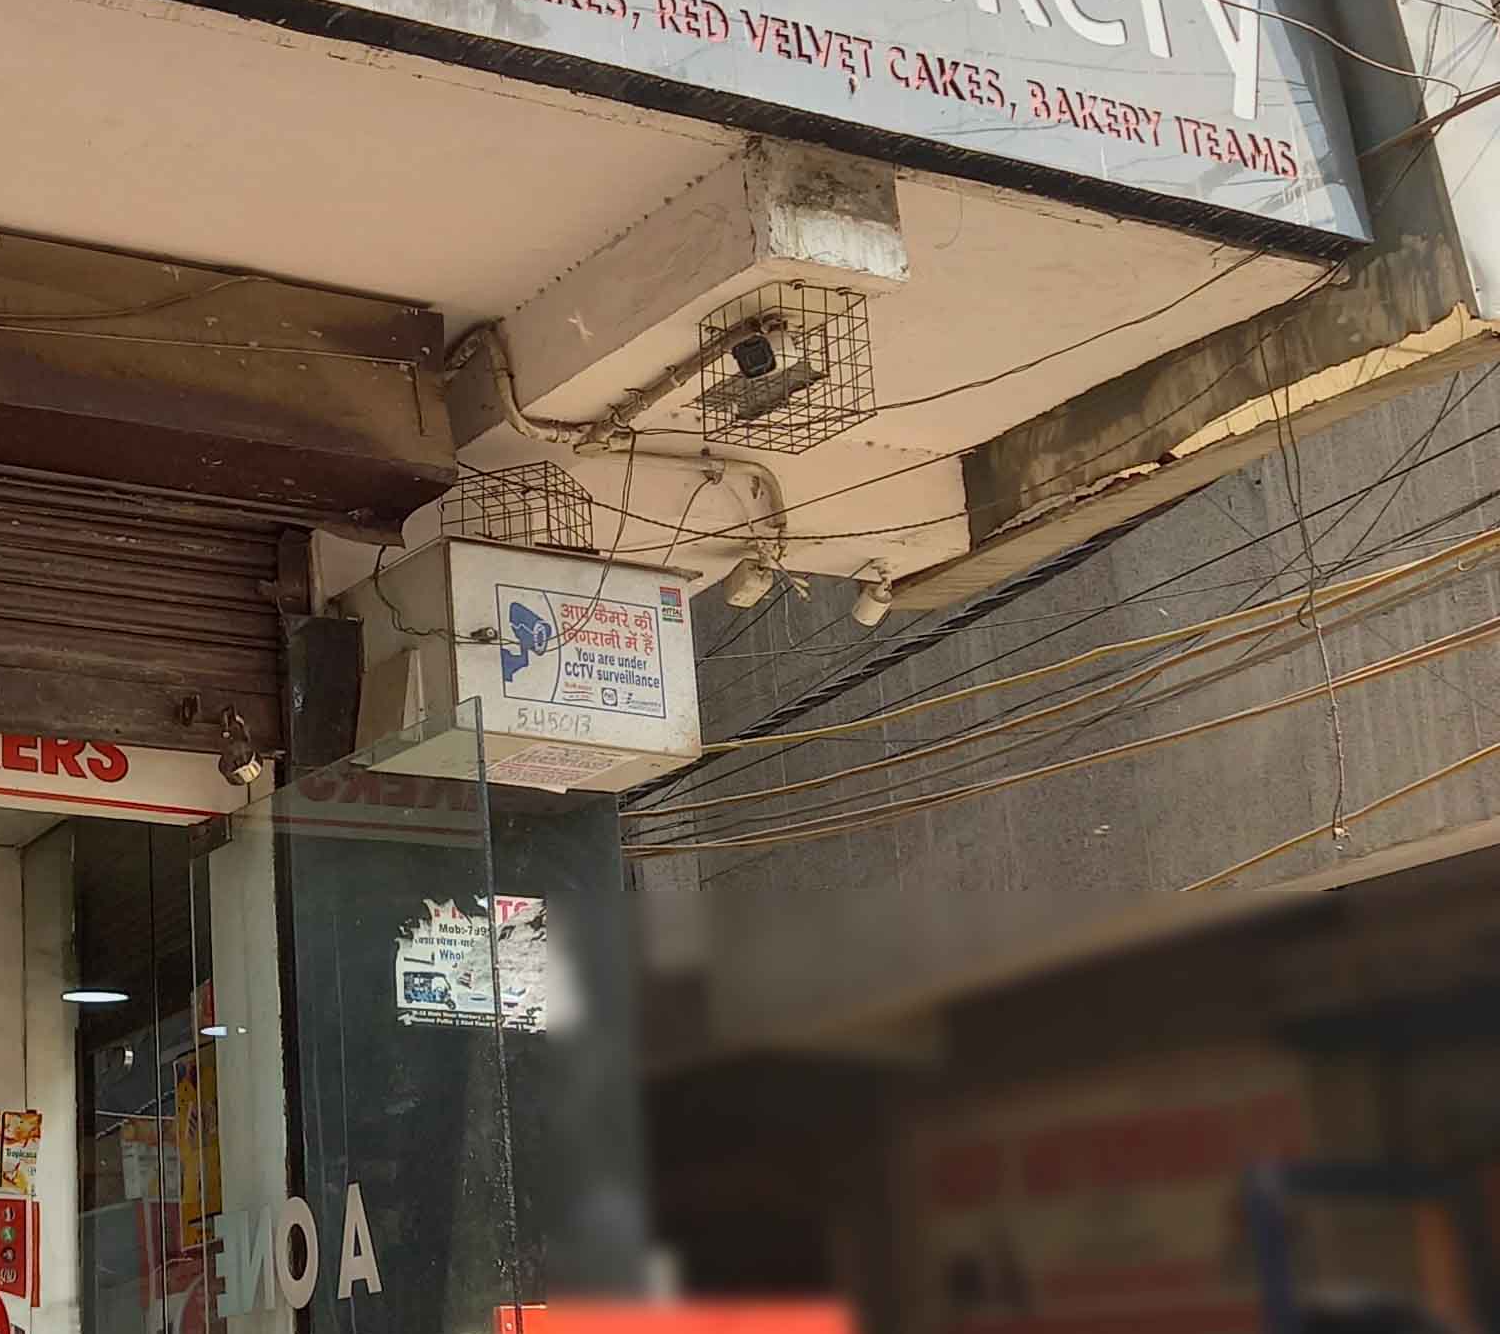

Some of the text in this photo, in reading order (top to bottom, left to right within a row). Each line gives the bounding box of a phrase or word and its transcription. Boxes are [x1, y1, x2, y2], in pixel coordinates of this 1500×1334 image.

[739, 8, 874, 80] VELVET
[888, 45, 1018, 122] CAKES,
[1026, 78, 1164, 148] BAKERY
[1173, 115, 1299, 181] ITEAMS
[634, 610, 654, 632] की
[575, 647, 648, 672] You are under
[564, 661, 594, 680] CCTV
[597, 668, 661, 689] surveillance
